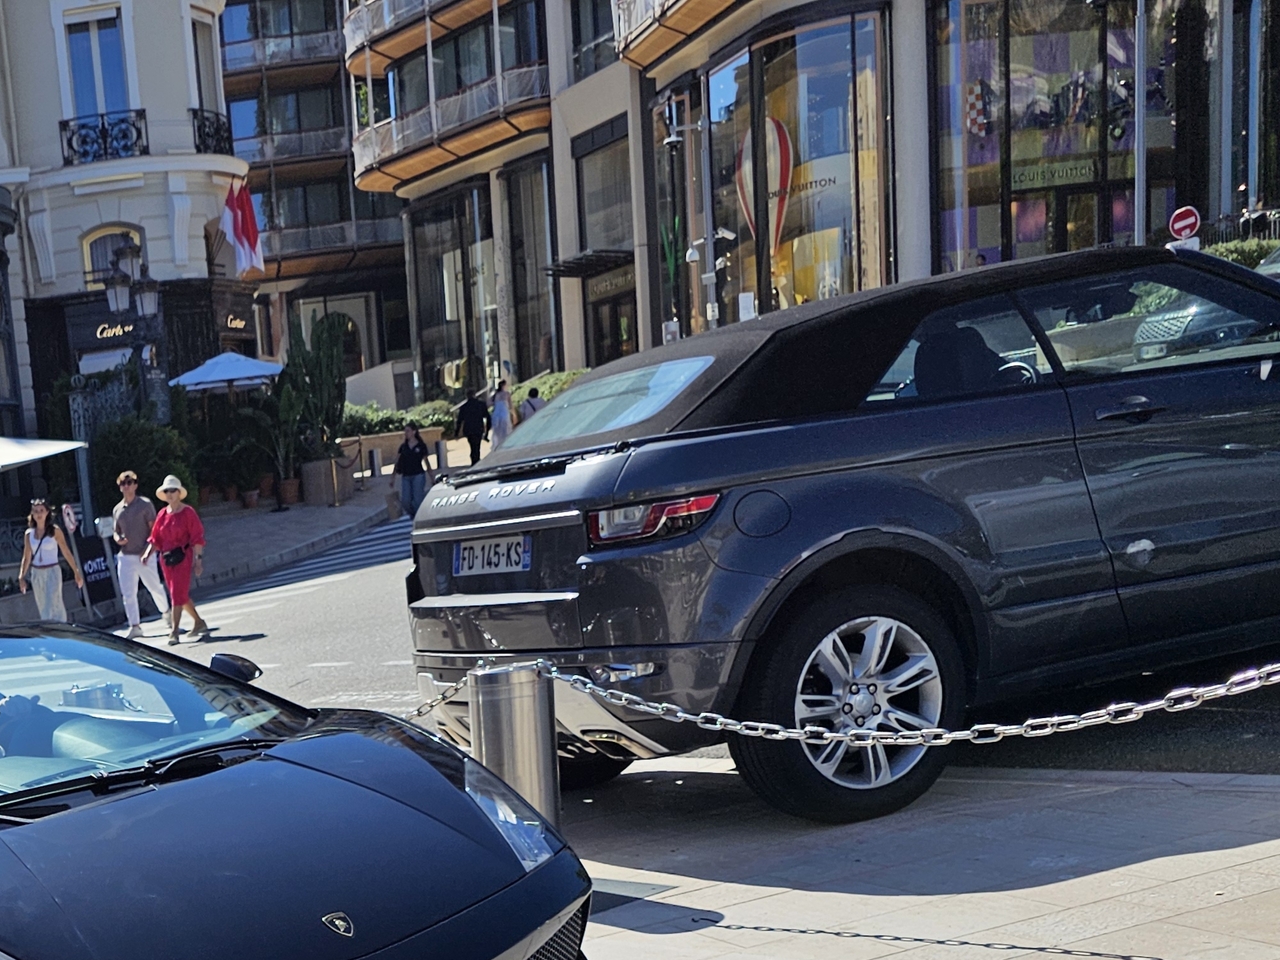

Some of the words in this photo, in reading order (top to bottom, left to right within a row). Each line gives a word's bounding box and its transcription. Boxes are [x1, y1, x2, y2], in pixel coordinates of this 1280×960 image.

[767, 187, 788, 200] OUIS
[790, 176, 837, 194] VUITTON
[1013, 170, 1047, 184] LOUIS
[431, 490, 480, 509] RANGE
[488, 479, 556, 500] ROVER
[461, 541, 522, 571] FD-145-KS
